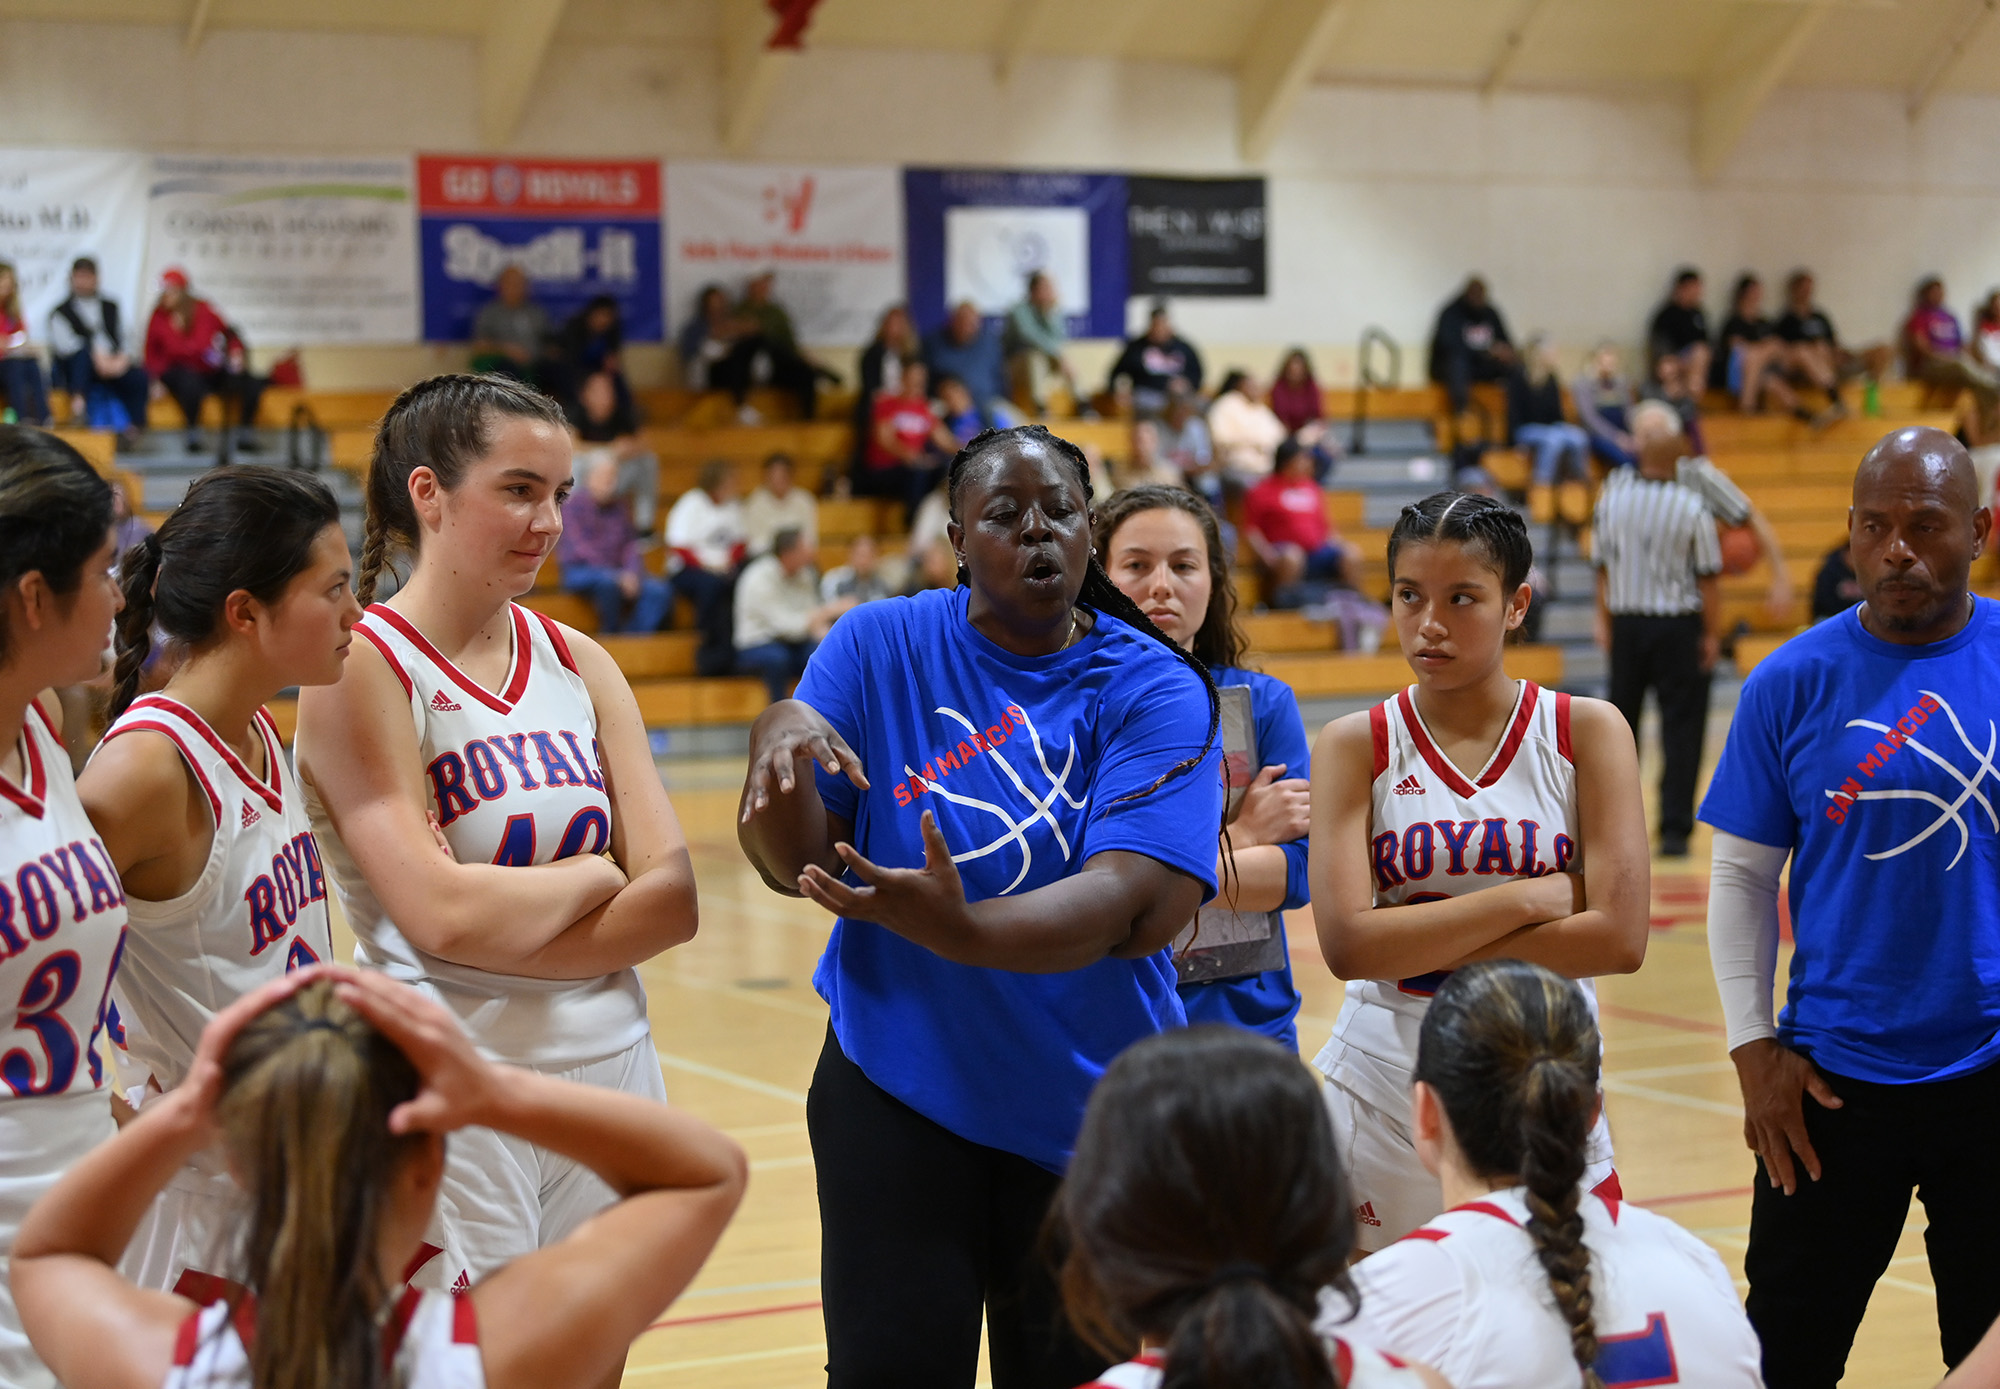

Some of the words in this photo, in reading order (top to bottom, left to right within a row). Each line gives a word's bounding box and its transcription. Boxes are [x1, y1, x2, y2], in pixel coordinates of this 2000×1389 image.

[431, 702, 462, 711] adidas
[893, 762, 938, 807] SAN
[935, 705, 1026, 777] MARCOS
[1392, 787, 1426, 795] adidas
[1826, 776, 1864, 825] SAN
[1857, 694, 1941, 778] MARCOS
[1372, 818, 1575, 892] ROYALS
